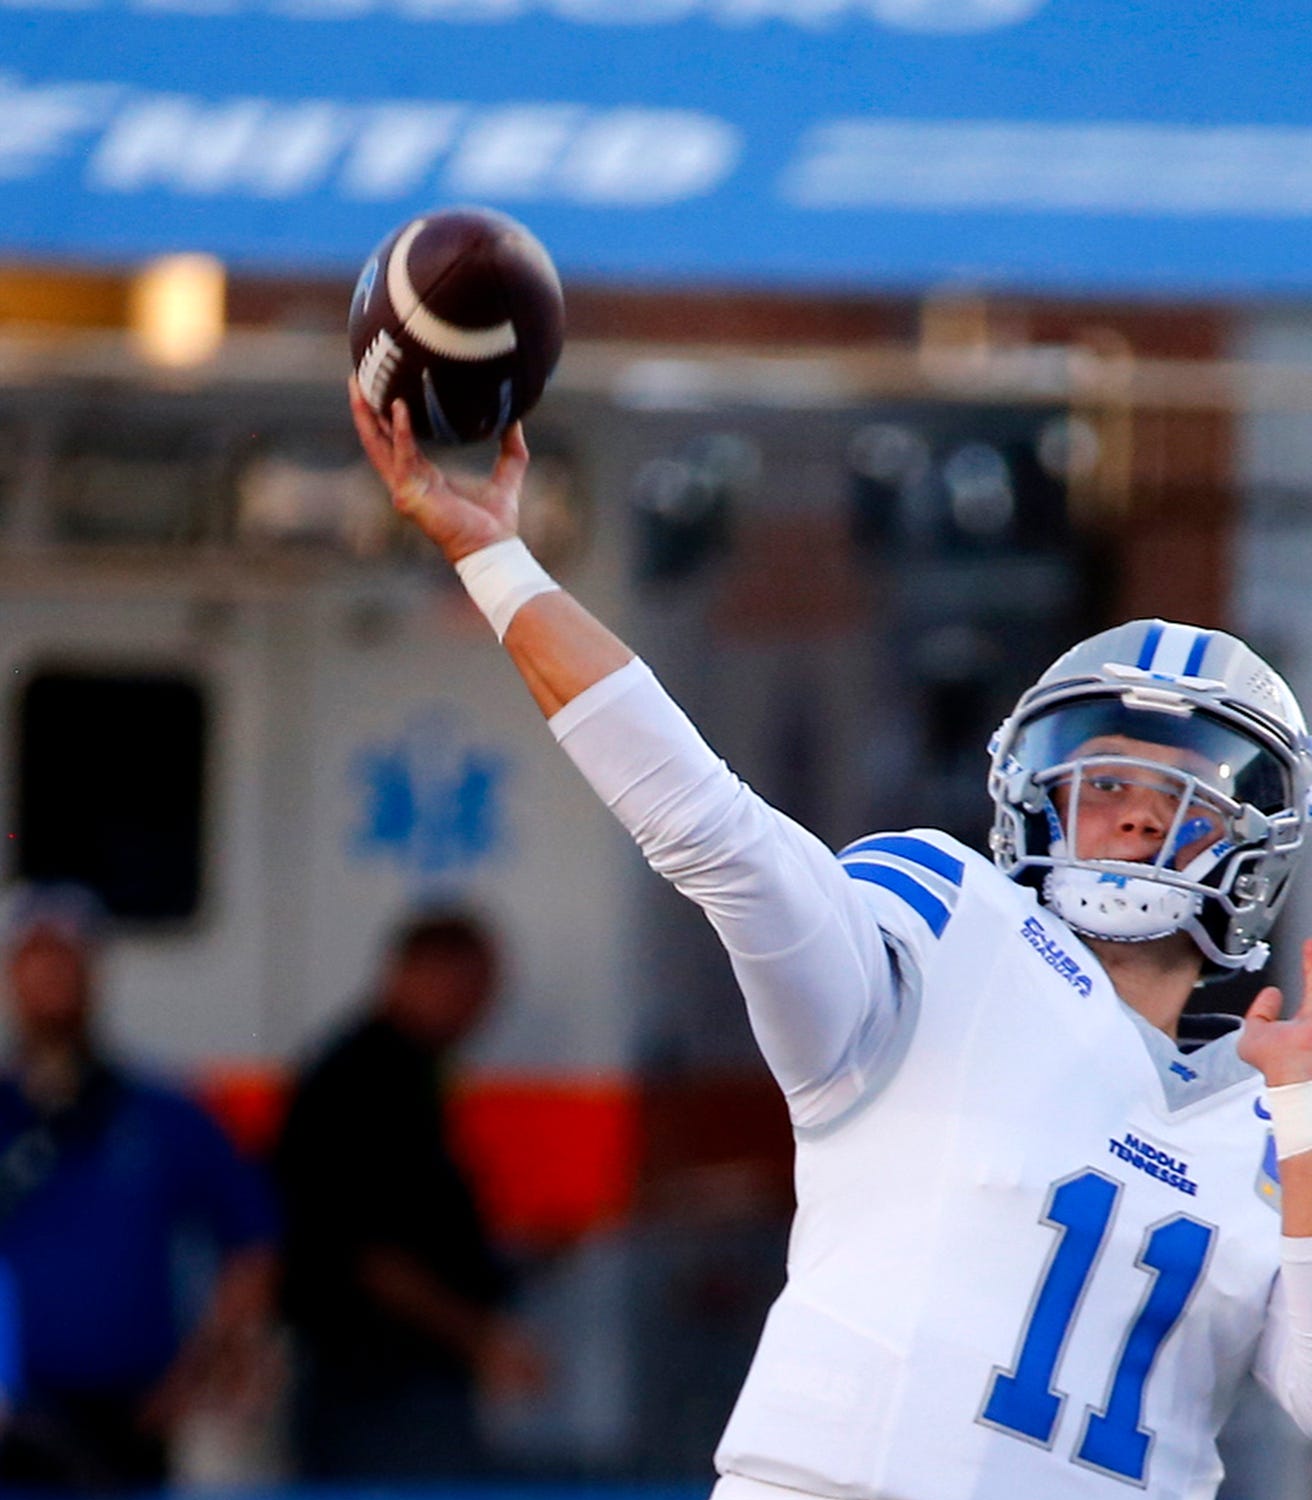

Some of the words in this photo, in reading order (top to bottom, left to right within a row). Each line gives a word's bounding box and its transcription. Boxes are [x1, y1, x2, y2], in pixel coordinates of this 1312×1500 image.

[1020, 928, 1090, 998] GRADUATE
[1109, 1138, 1198, 1197] TENNESSEE
[1124, 1133, 1188, 1175] MIDDLE
[974, 1165, 1219, 1490] 11
